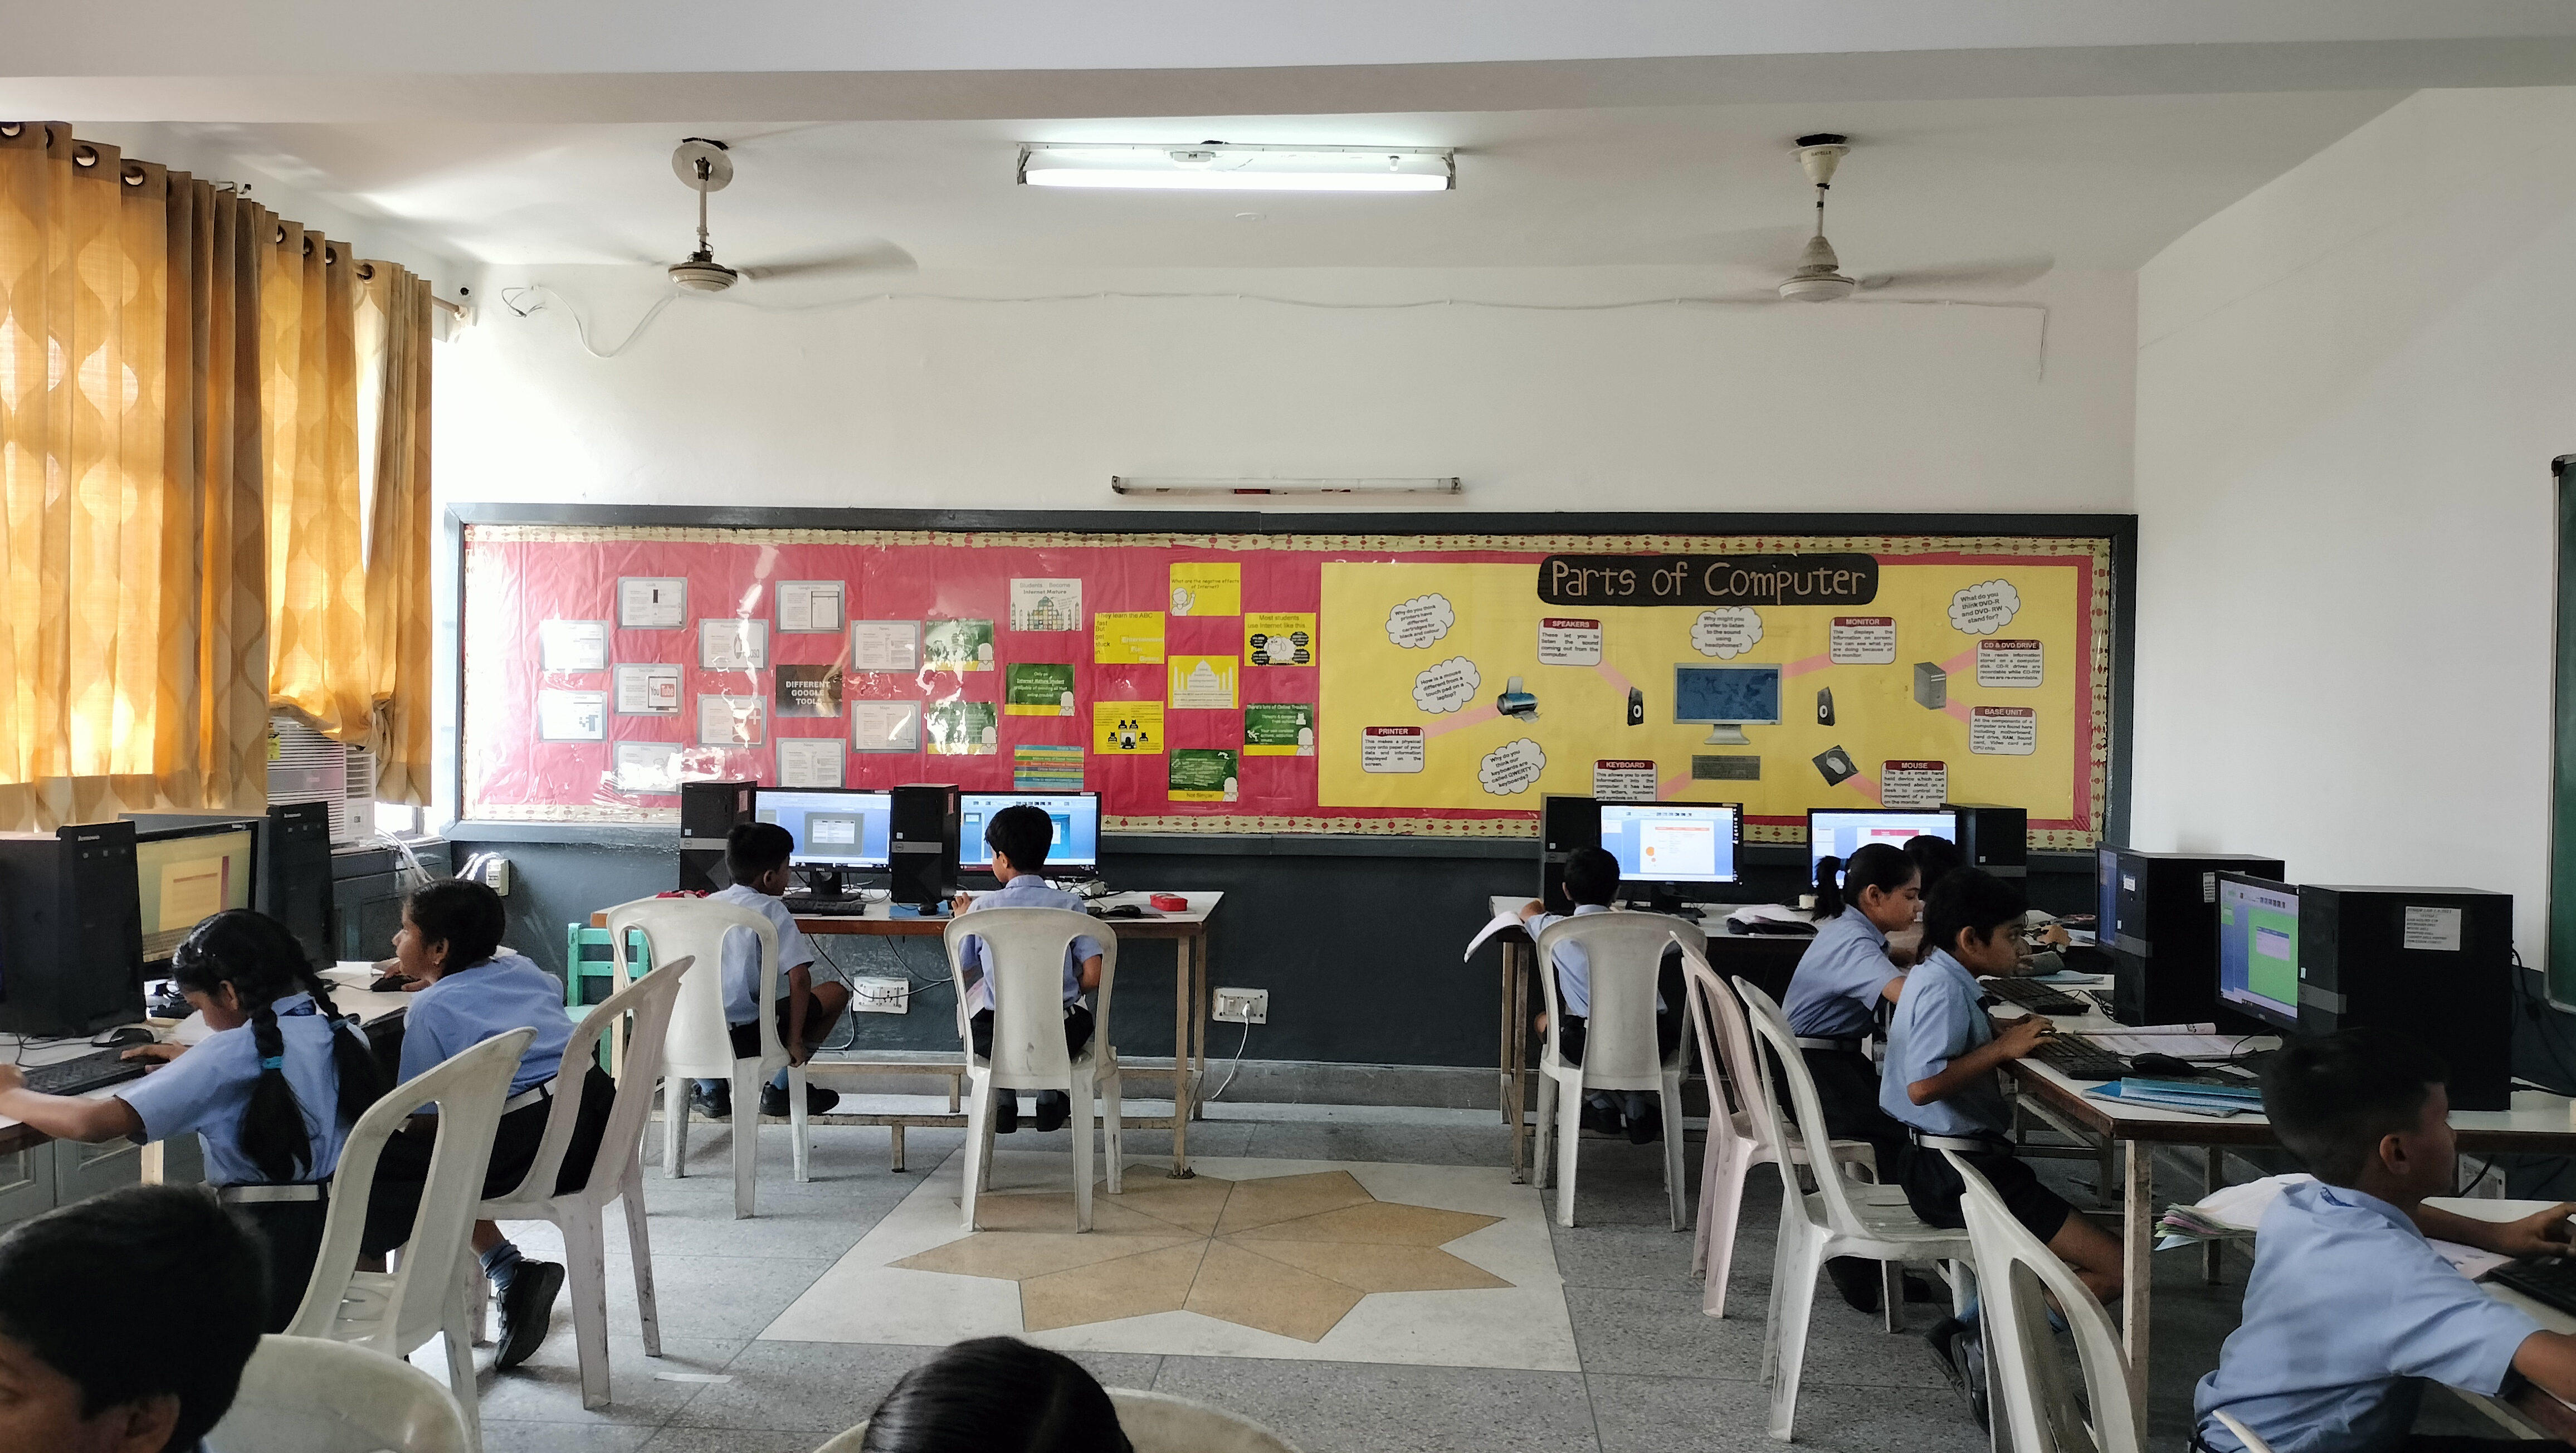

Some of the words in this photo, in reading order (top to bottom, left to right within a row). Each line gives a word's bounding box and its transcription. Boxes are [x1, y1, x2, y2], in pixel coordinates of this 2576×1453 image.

[1553, 561, 1635, 596] Parts
[1652, 562, 1687, 596] of
[1704, 562, 1865, 604] Computer
[651, 686, 659, 695] You
[661, 686, 674, 695] Tube
[1423, 681, 1446, 691] different
[1437, 691, 1456, 700] laptop?
[1491, 765, 1518, 776] keyboards
[1492, 774, 1507, 783] called
[1508, 766, 1531, 777] QWERTY
[1499, 774, 1528, 787] keyboards?
